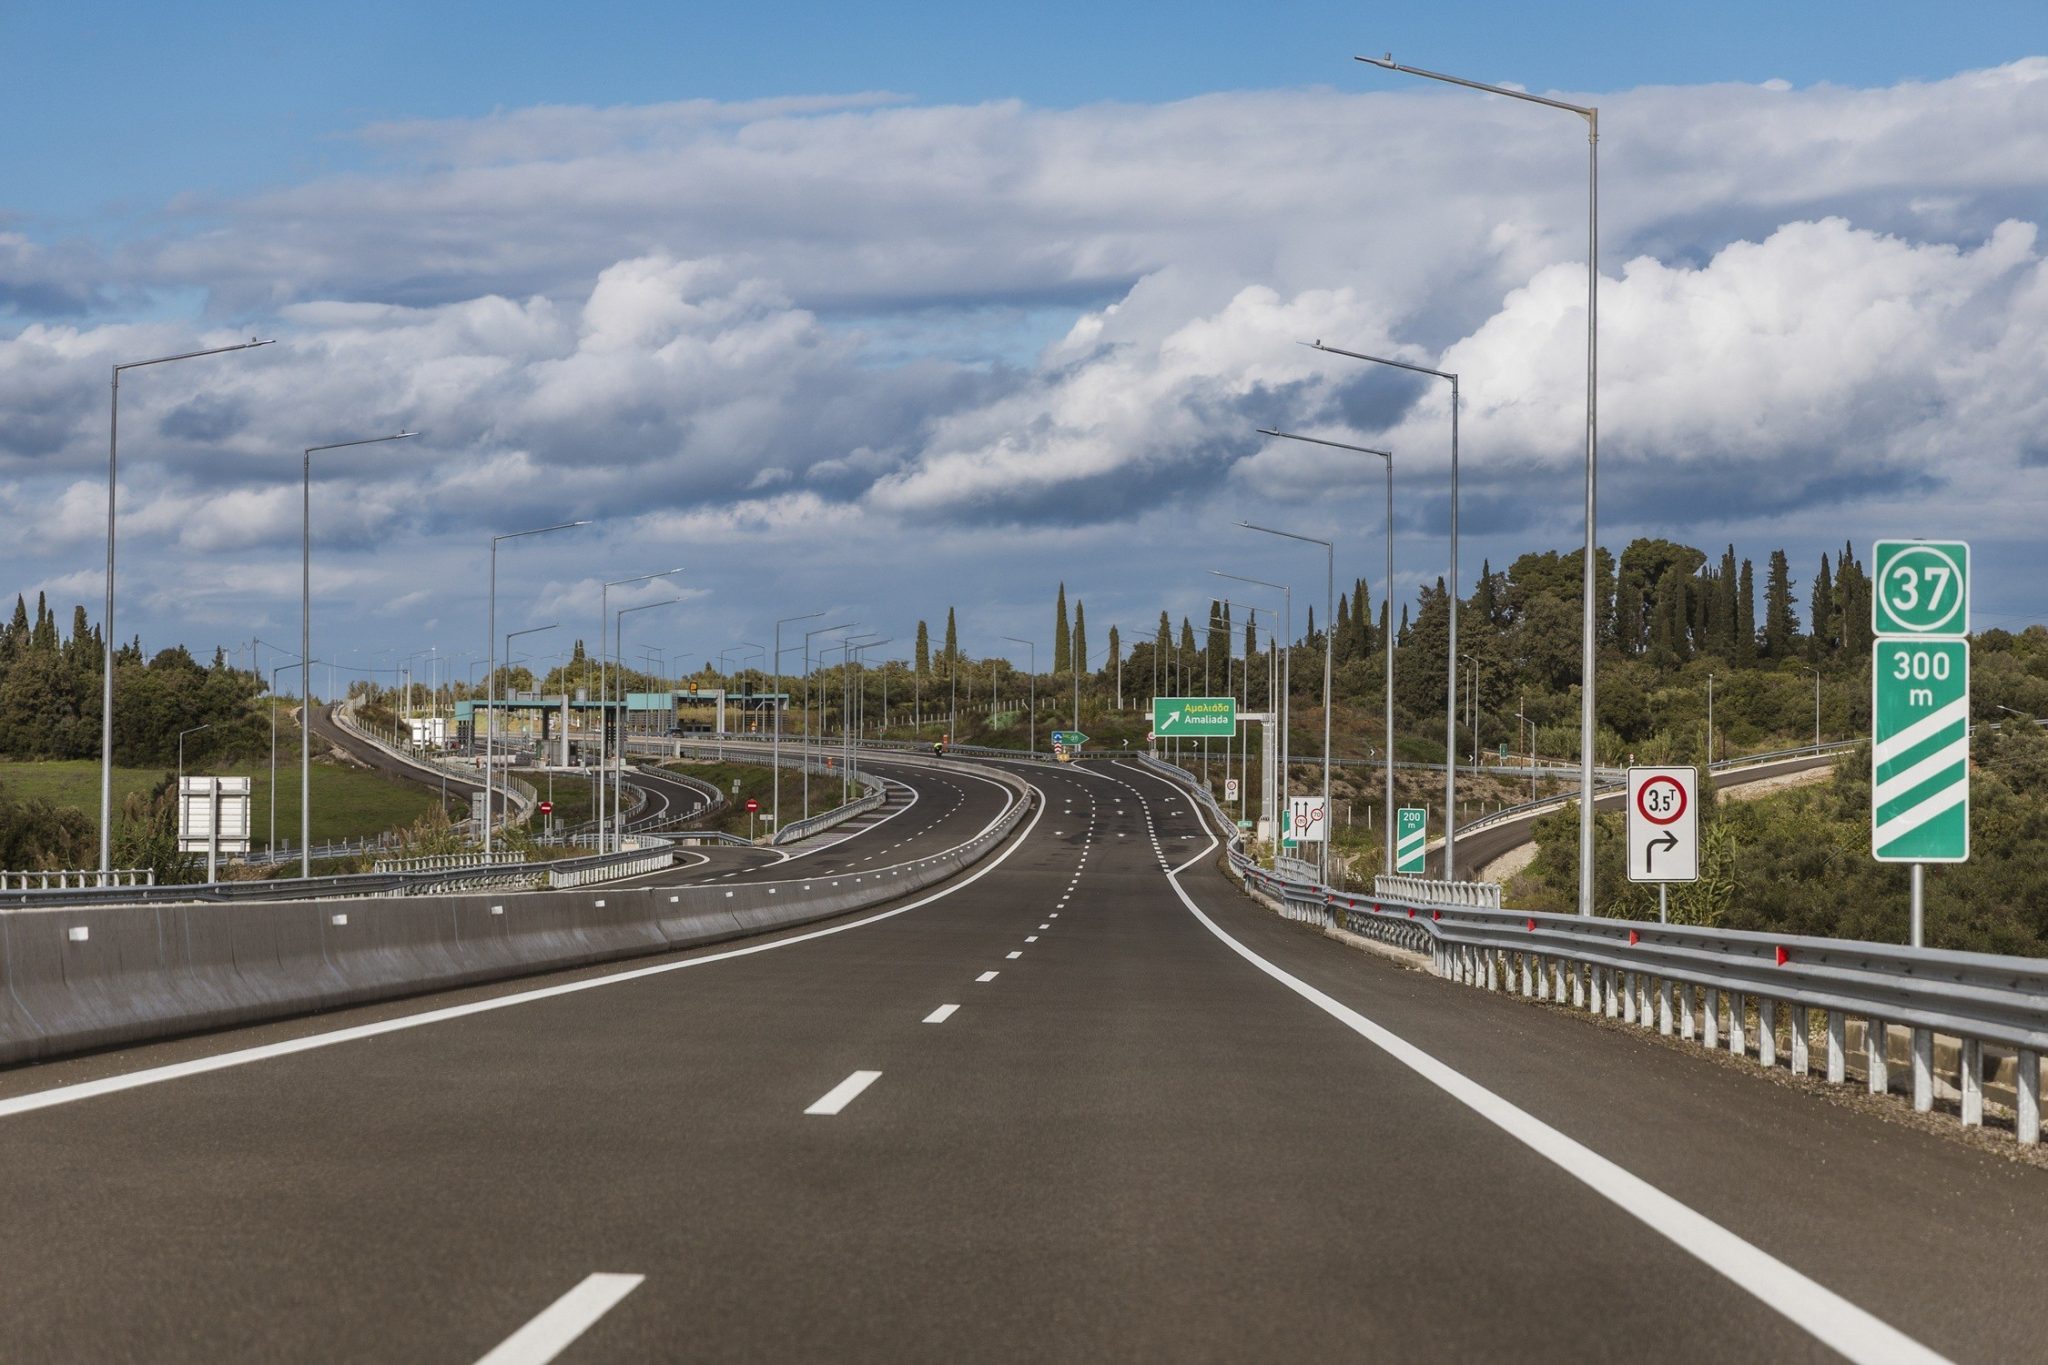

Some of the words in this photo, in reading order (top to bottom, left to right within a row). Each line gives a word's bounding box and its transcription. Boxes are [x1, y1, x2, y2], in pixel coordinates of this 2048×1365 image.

[1892, 566, 1951, 611] 37
[1893, 651, 1950, 680] 300
[1909, 688, 1933, 707] m
[1185, 715, 1228, 724] Amaliada
[1403, 812, 1421, 821] 200
